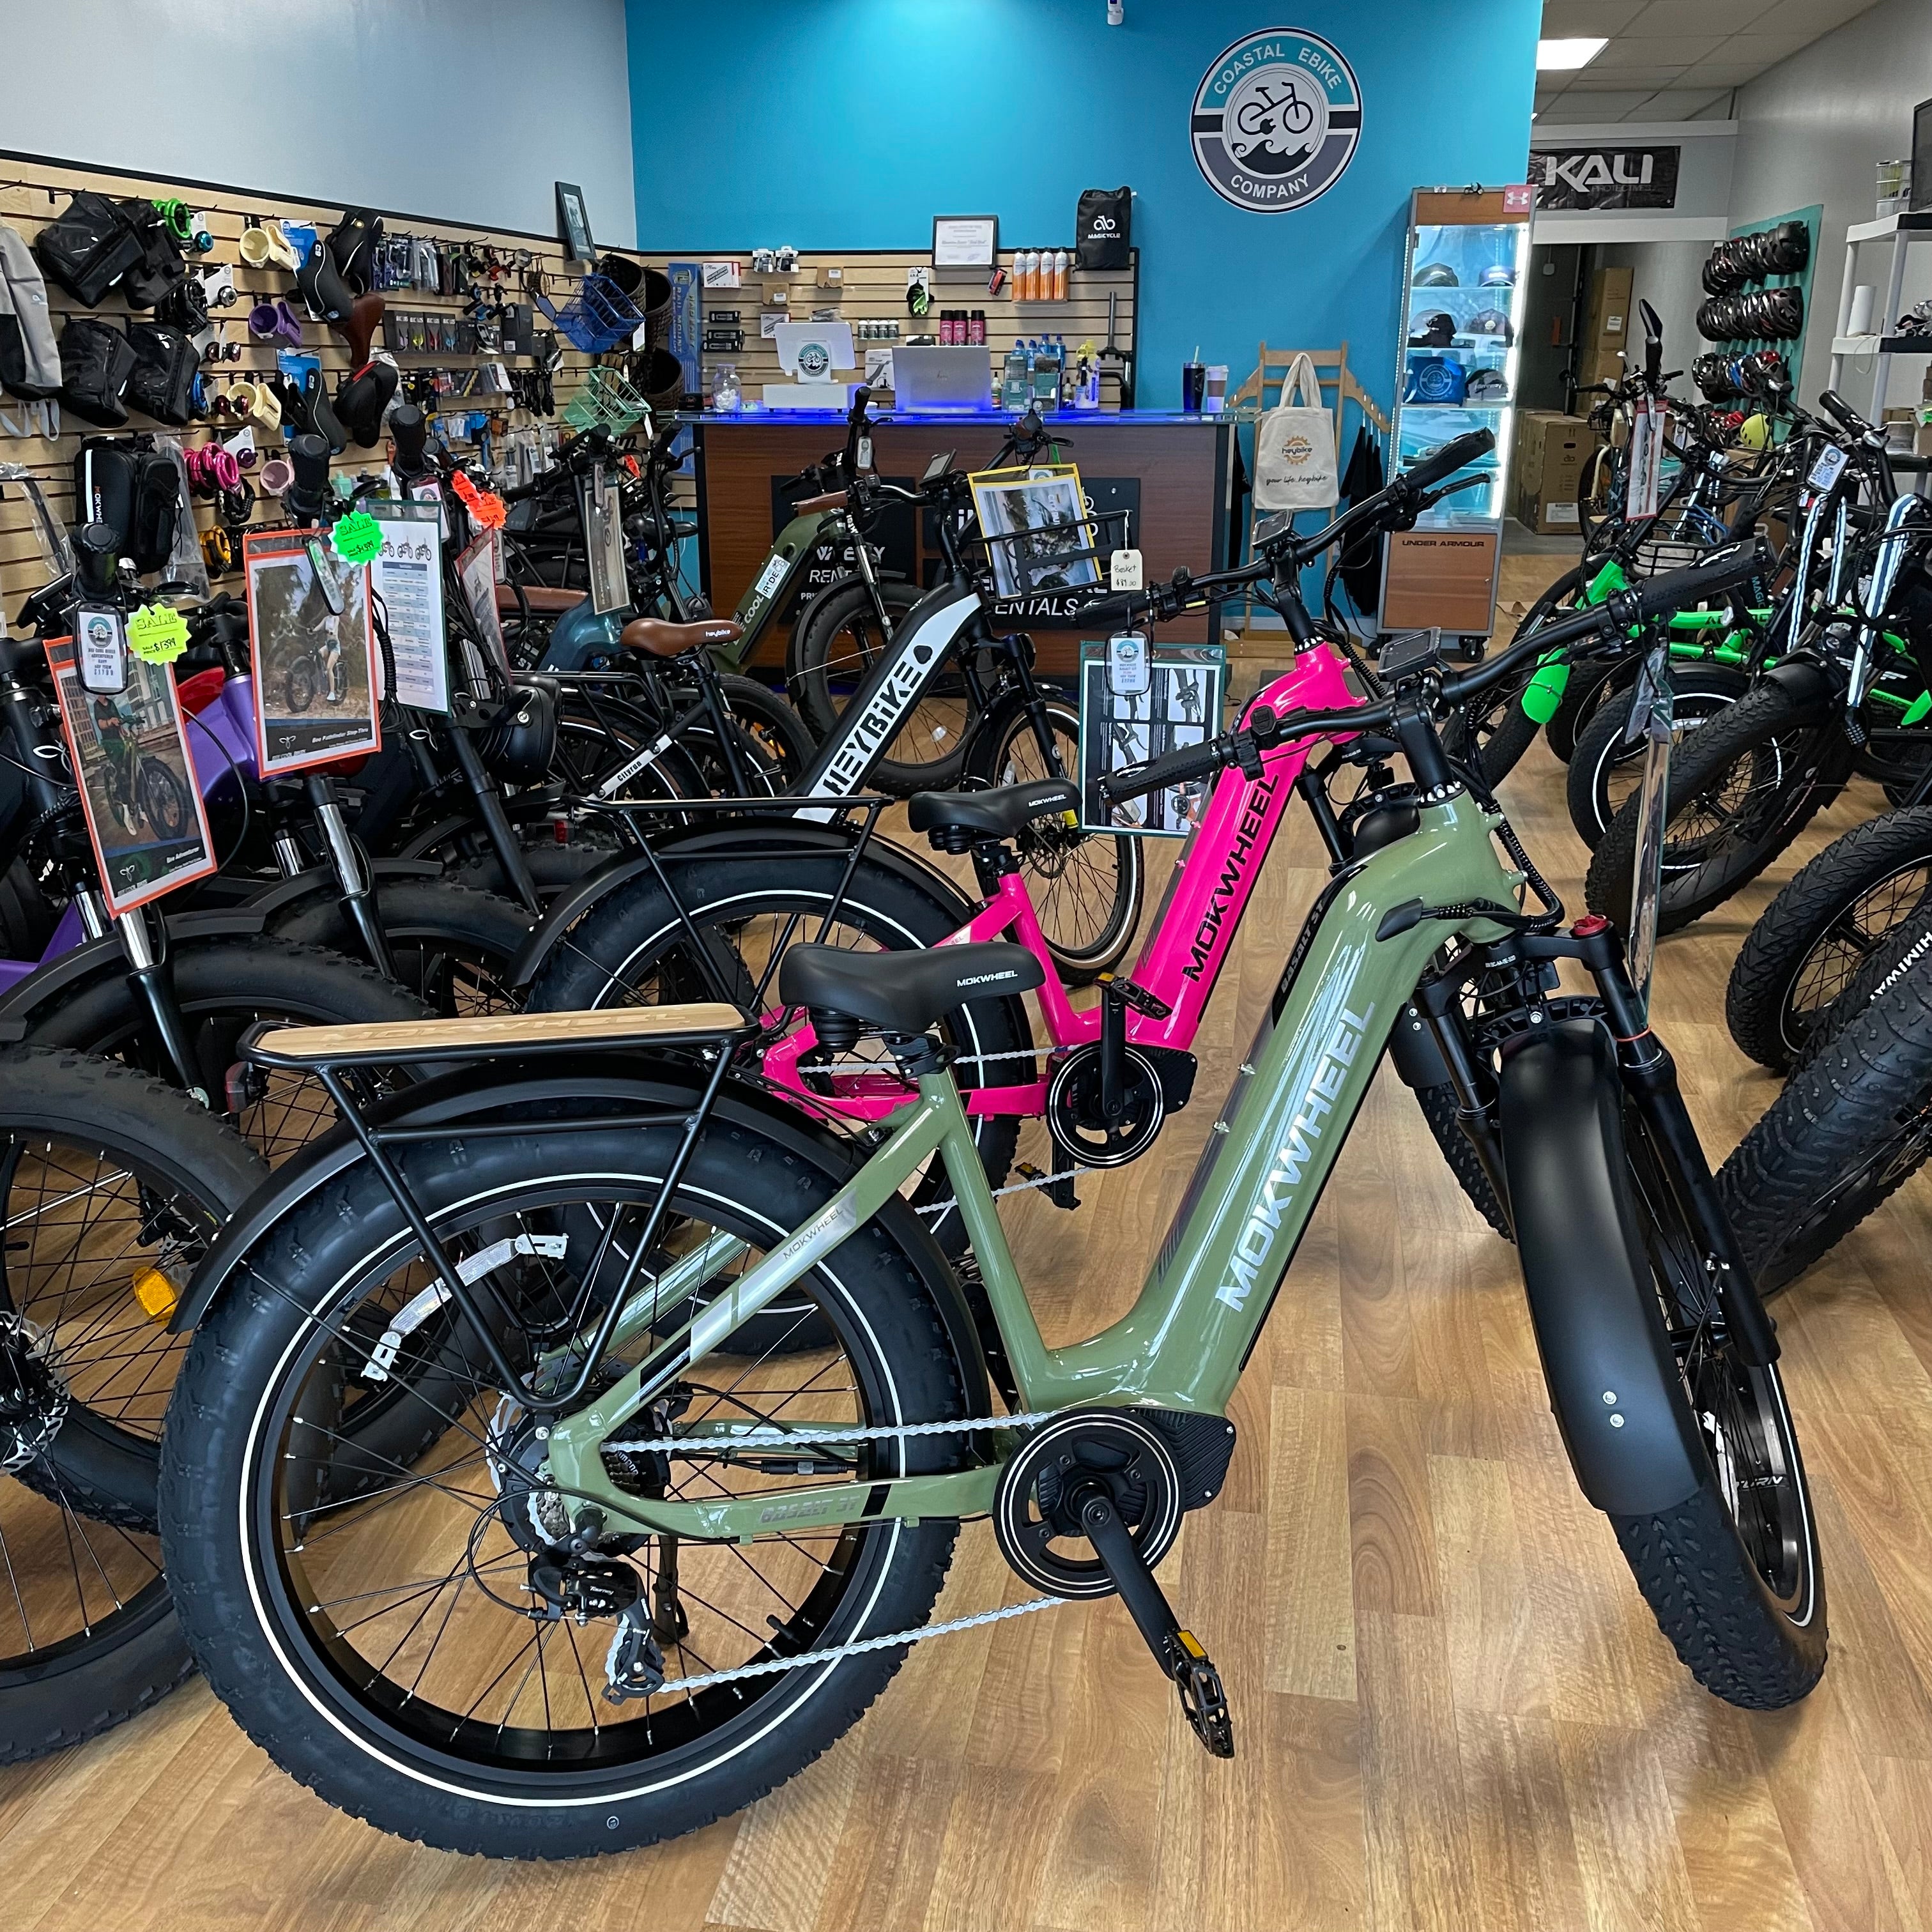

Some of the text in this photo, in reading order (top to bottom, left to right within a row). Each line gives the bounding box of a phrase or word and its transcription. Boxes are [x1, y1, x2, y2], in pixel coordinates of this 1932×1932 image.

[1213, 43, 1342, 95] COASTAL EBIKE
[1544, 154, 1654, 192] KALI
[1230, 173, 1310, 199] COMPANY
[1282, 447, 1313, 455] heybike
[94, 486, 103, 523] MOKWHE
[339, 518, 373, 537] SALE
[1113, 564, 1137, 573] Basket
[744, 595, 764, 624] COOL
[995, 597, 1079, 617] ENTALS
[135, 613, 178, 631] SALE
[1028, 793, 1067, 807] MOKWHEEL
[1181, 772, 1281, 983] MOKWHEEL
[956, 969, 1018, 988] MOKWHEEL
[1215, 1001, 1376, 1313] MOKWHEEL
[783, 1208, 844, 1260] MOKWHEEL
[589, 1585, 615, 1596] Tourney
